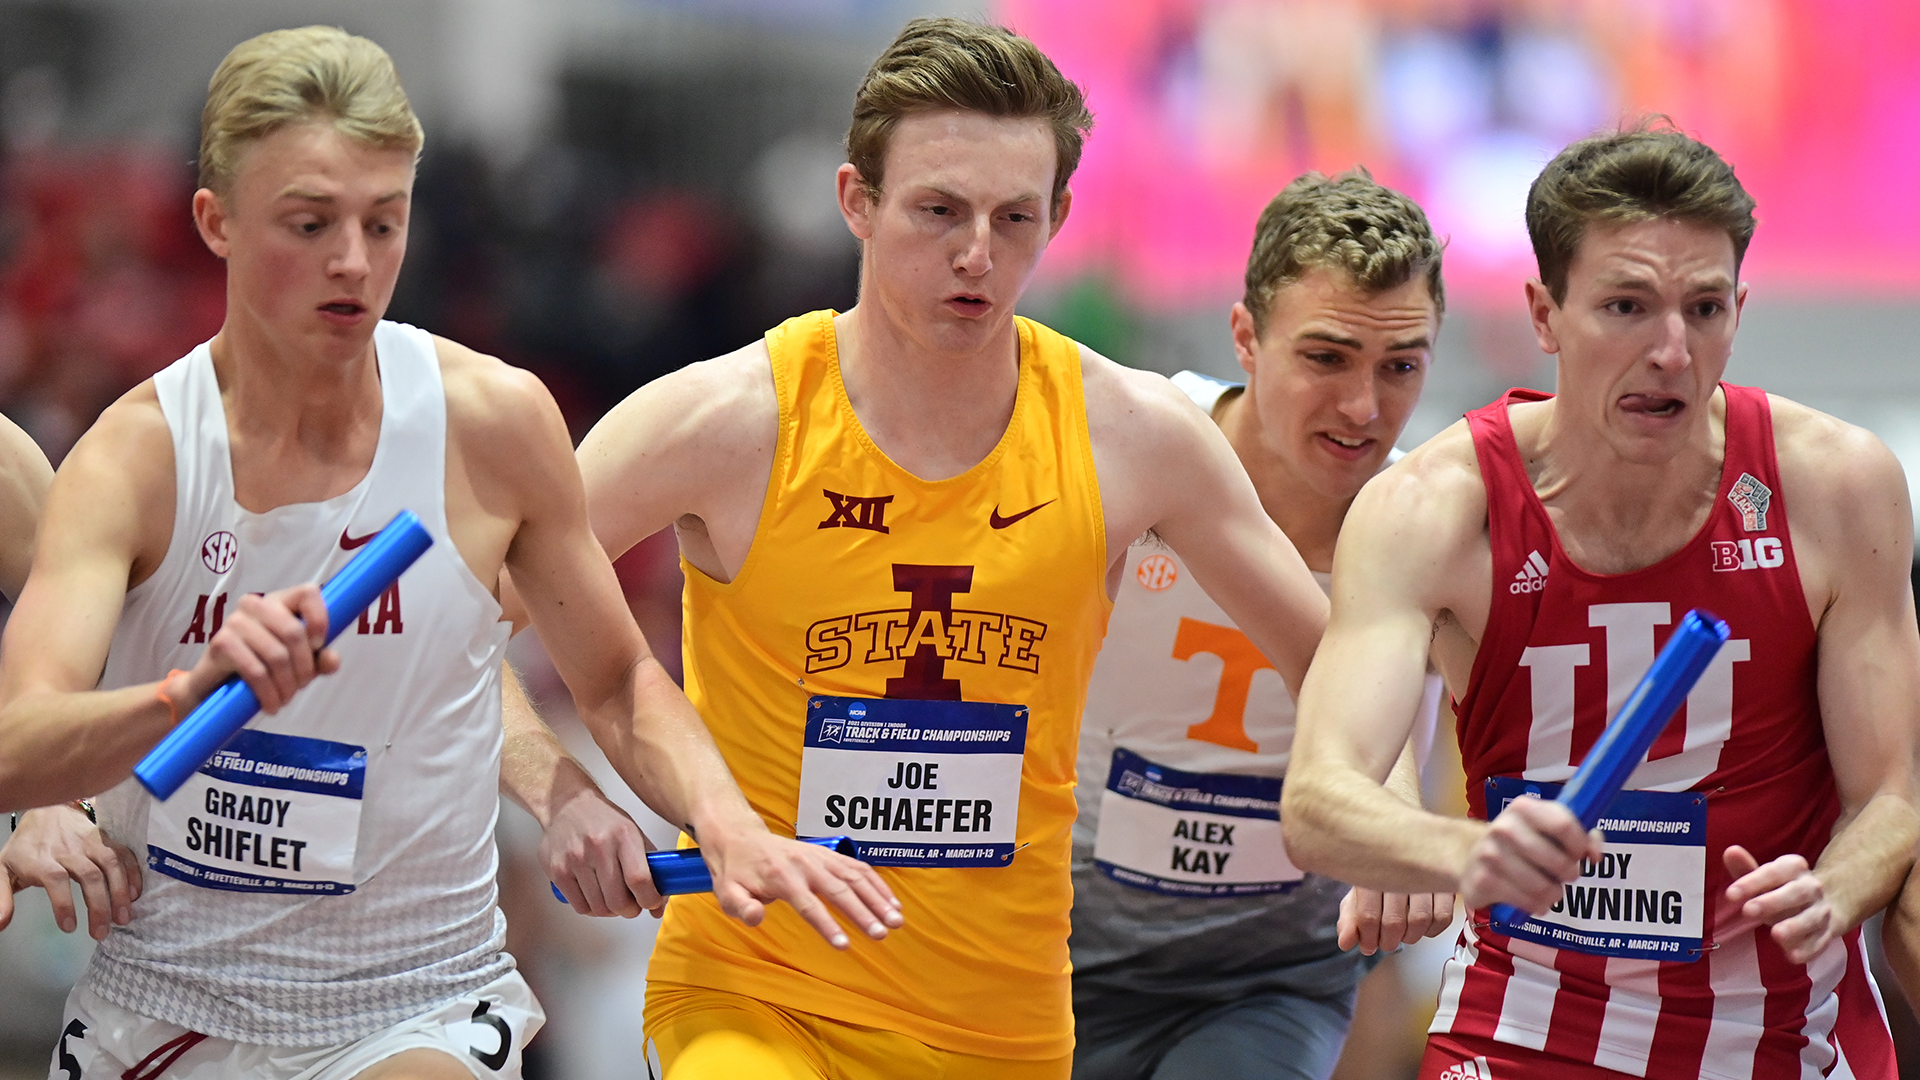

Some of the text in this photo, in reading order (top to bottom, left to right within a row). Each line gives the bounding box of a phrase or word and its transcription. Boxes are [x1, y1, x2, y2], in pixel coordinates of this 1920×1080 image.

[817, 489, 895, 534] XII
[1730, 491, 1756, 514] PEACE
[202, 531, 237, 574] SEC
[1137, 554, 1178, 591] SEC
[805, 608, 1048, 674] STATE
[1171, 616, 1279, 754] T
[849, 709, 867, 717] NCAA
[845, 725, 1011, 742] TRACK & FIELD CHAMPIONSHIPS
[213, 756, 223, 767] &
[222, 757, 255, 773] FIELD
[255, 761, 350, 786] CHAMPIONSHIPS
[887, 761, 939, 790] JOE
[205, 787, 291, 828] GRADY
[824, 795, 992, 832] SCHAEFER
[1173, 818, 1236, 846] ALEX
[1596, 818, 1691, 834] CHAMPIONSHIPS
[186, 817, 307, 872] SHIFLET
[867, 847, 926, 859] FAYETTEVILLE,
[927, 848, 940, 858] AR
[945, 848, 974, 859] MARCH
[975, 848, 995, 859] 11-13
[1171, 845, 1231, 875] KAY
[1552, 928, 1607, 948] FAYETTEVILLE,
[1608, 938, 1621, 949] AR
[1628, 939, 1659, 951] MARCH
[1660, 941, 1680, 952] 11-13
